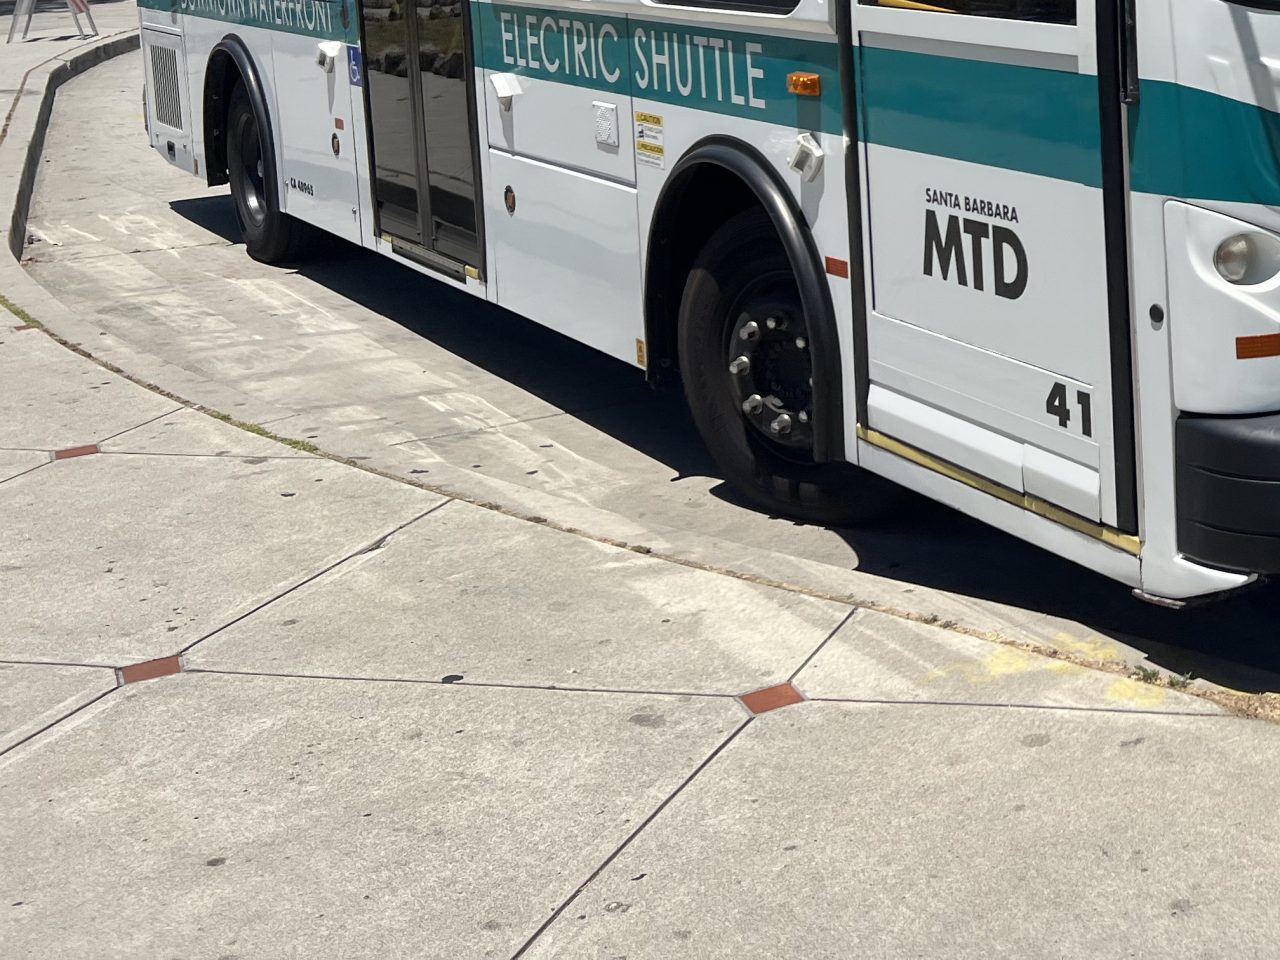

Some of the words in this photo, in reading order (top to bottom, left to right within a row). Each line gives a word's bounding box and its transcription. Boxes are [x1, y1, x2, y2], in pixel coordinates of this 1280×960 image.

[500, 11, 621, 84] ELECTRIC
[634, 27, 767, 109] SHUTTLE
[640, 113, 661, 125] CAUTION
[925, 187, 961, 211] SANTA
[964, 195, 1019, 224] BARBARA
[923, 208, 1029, 301] MTD
[1045, 380, 1093, 439] 41
